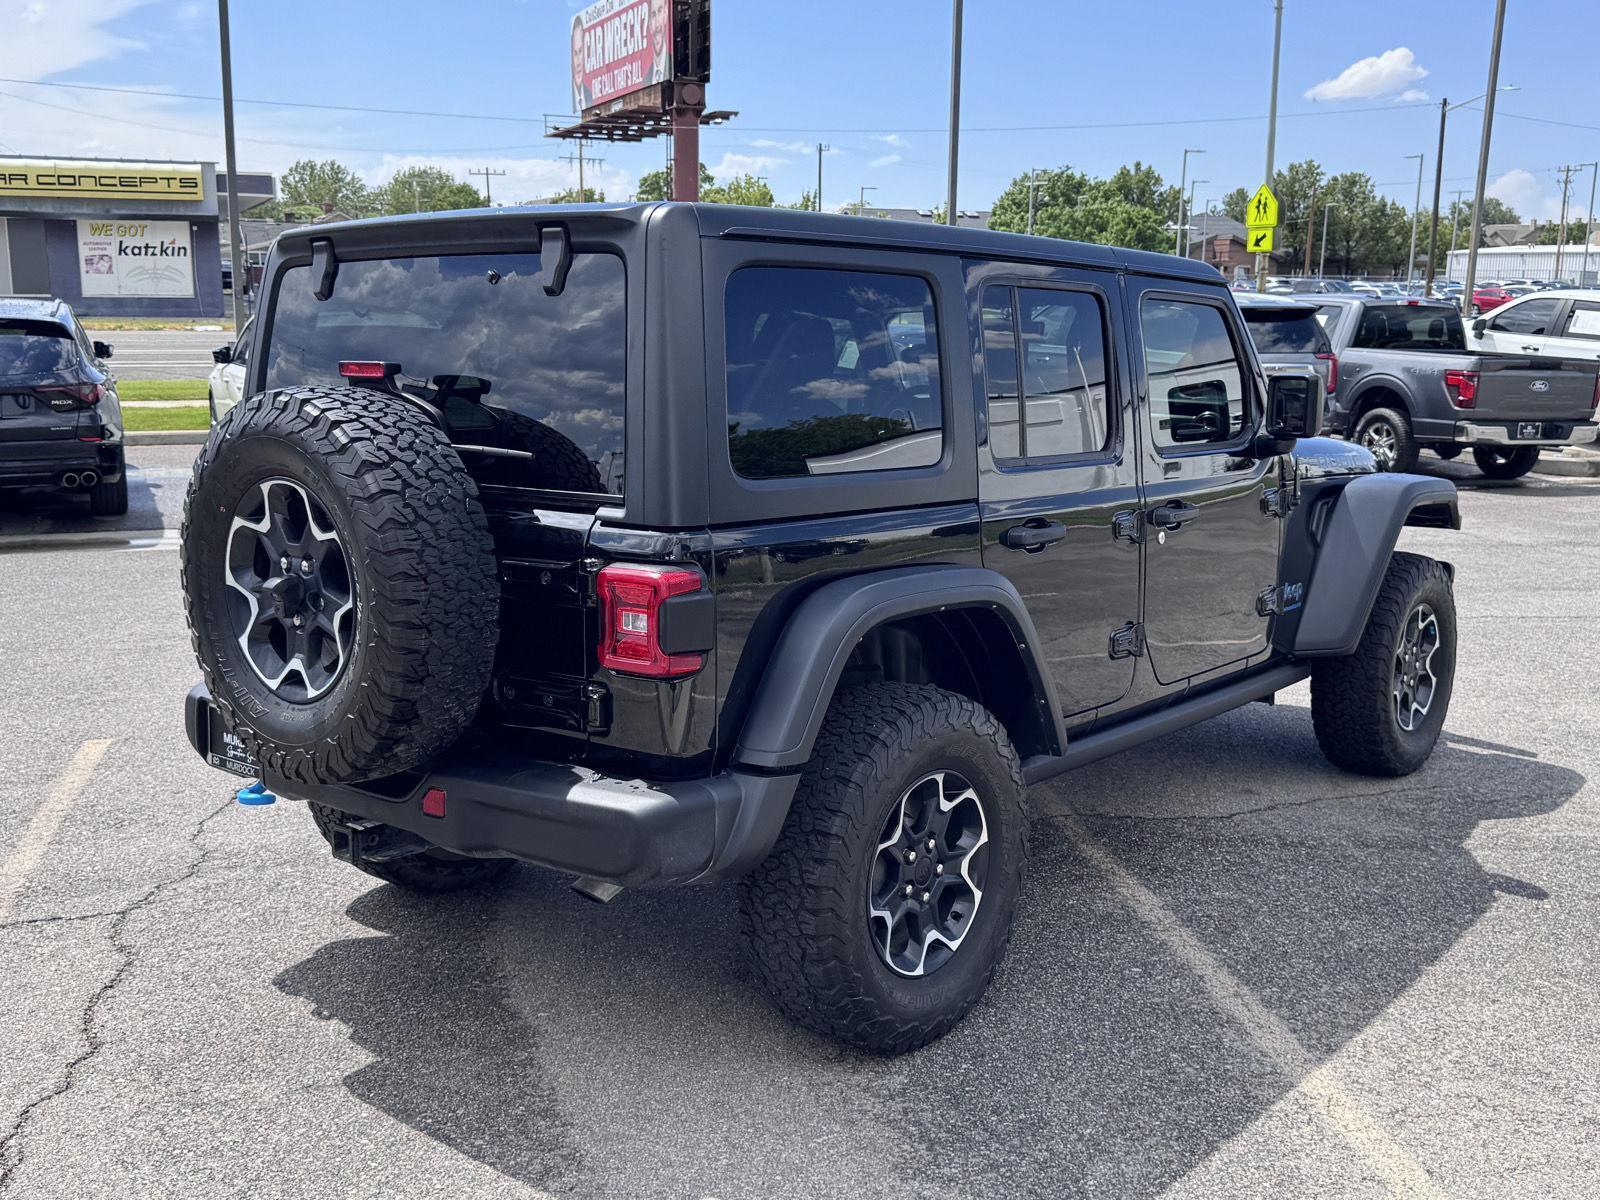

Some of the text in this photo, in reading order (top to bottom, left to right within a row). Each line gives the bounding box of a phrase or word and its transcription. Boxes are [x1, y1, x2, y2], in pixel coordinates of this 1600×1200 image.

[584, 2, 649, 74] CAR WRECK?
[36, 174, 198, 189] CONCEPTS
[89, 223, 147, 238] WE GOT
[118, 238, 188, 257] katzkin
[1284, 582, 1303, 601] Jeep
[226, 761, 256, 777] MURDOCK
